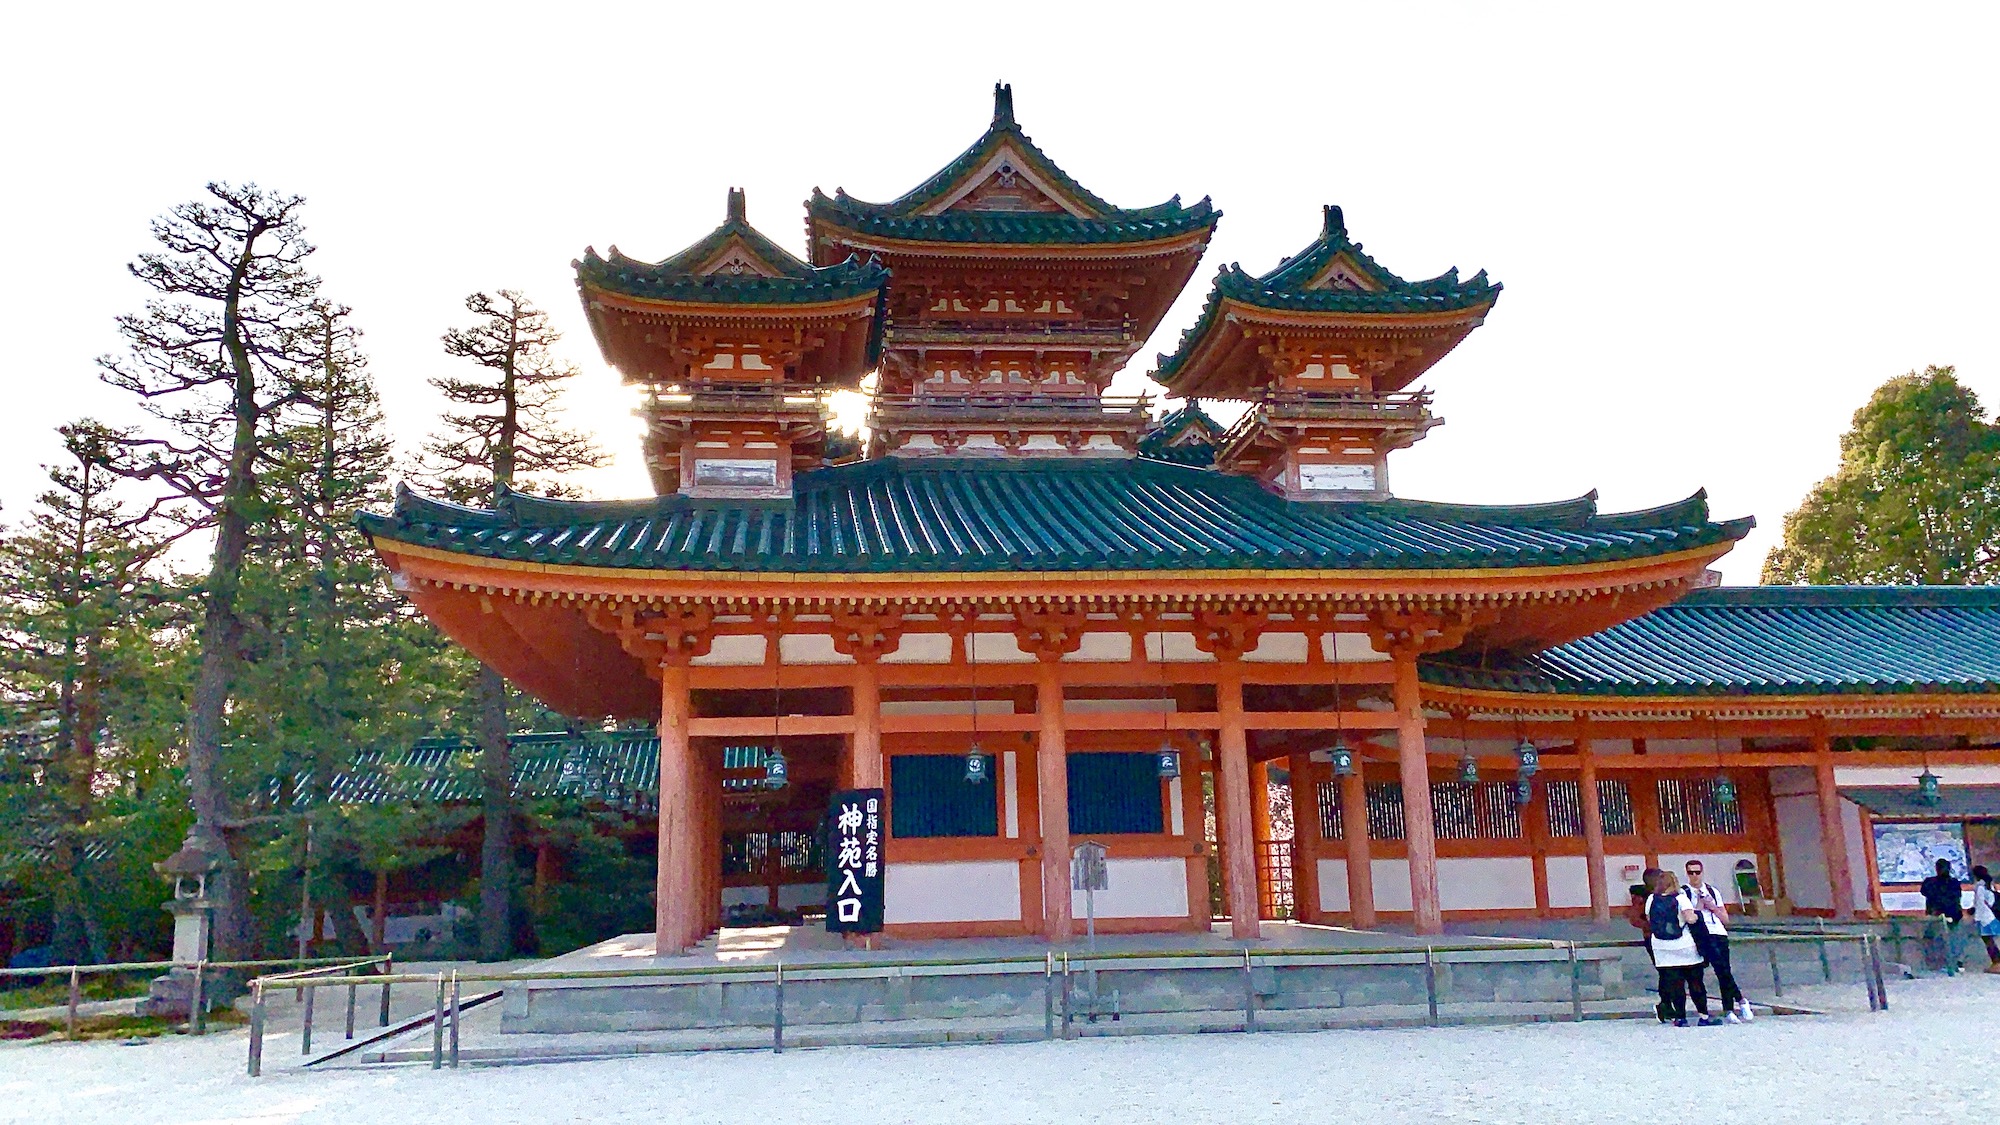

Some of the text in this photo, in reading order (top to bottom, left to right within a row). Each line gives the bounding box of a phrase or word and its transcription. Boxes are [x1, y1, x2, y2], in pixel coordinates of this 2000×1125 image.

[837, 803, 863, 922] 神苑入口
[865, 798, 878, 878] 国指定名勝
